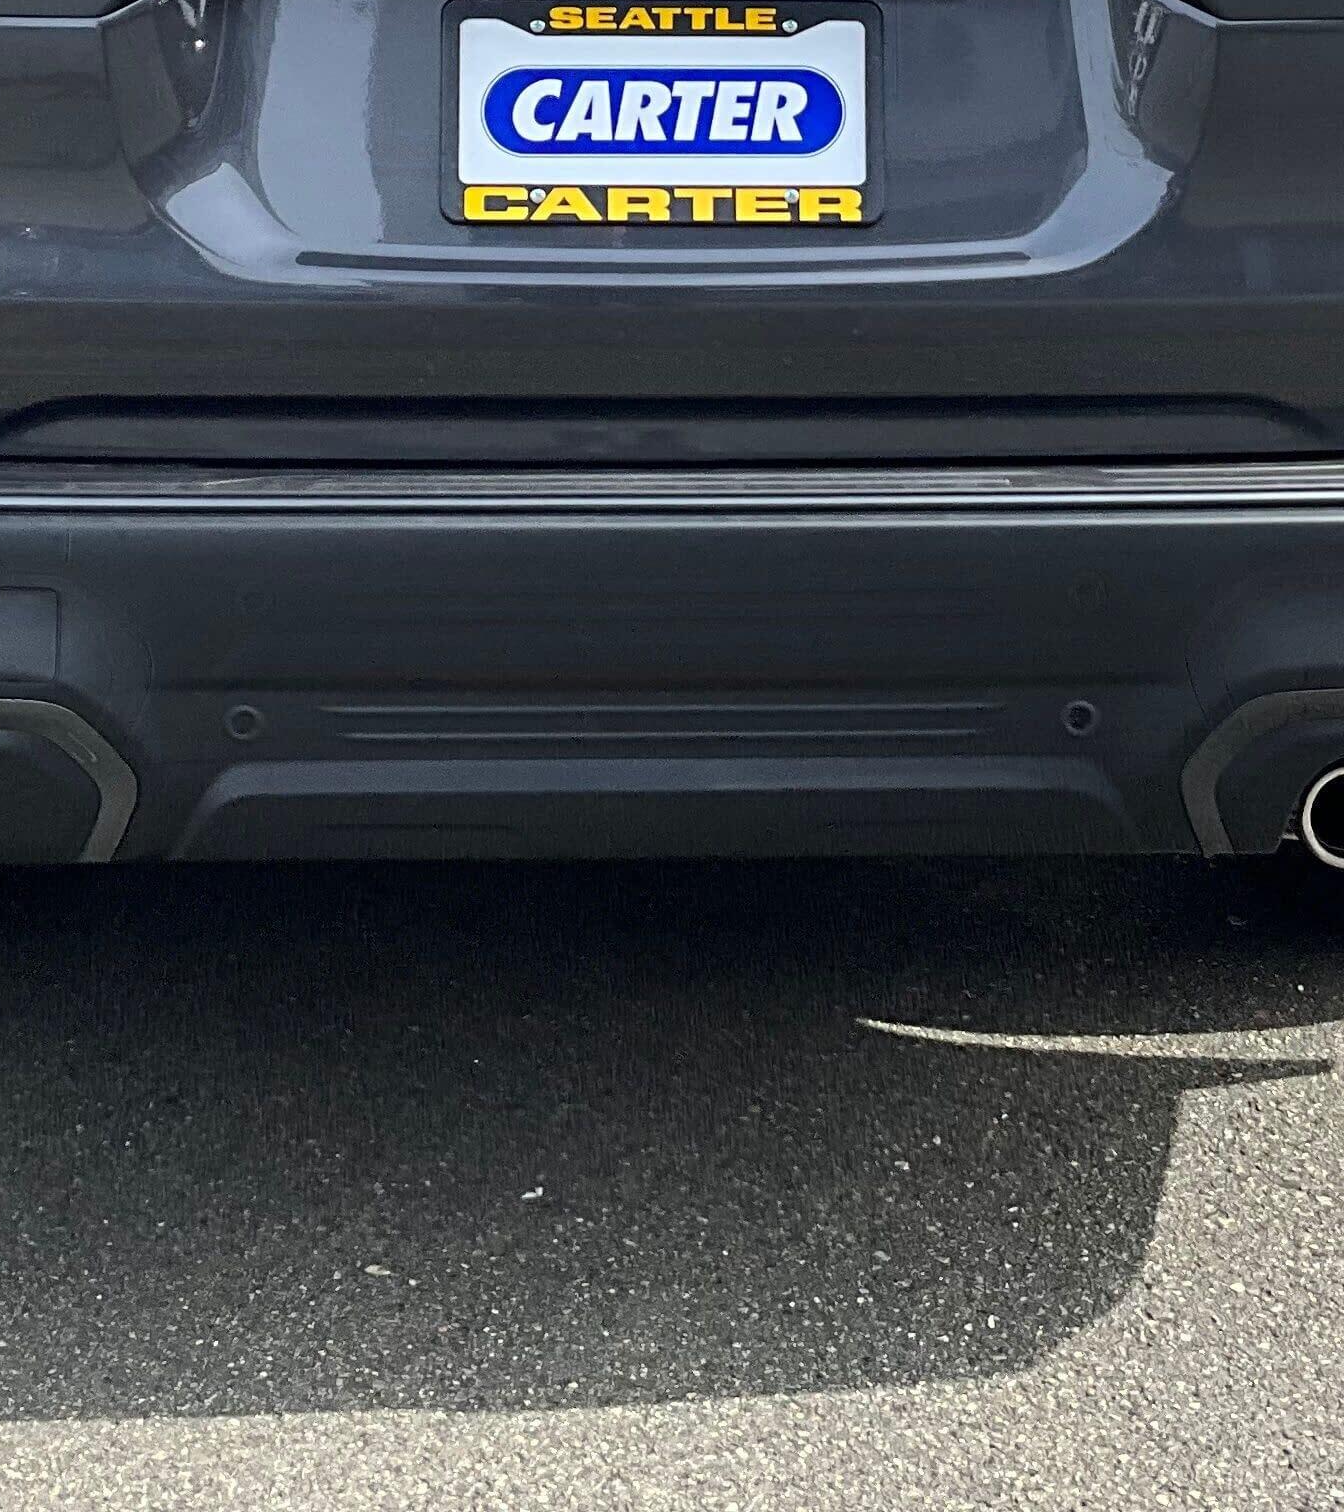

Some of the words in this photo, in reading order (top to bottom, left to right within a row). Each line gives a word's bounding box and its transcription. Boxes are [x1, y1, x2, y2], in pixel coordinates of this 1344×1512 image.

[549, 6, 777, 31] SEATTLE
[511, 78, 808, 142] CARTER
[463, 186, 863, 223] CARTER
